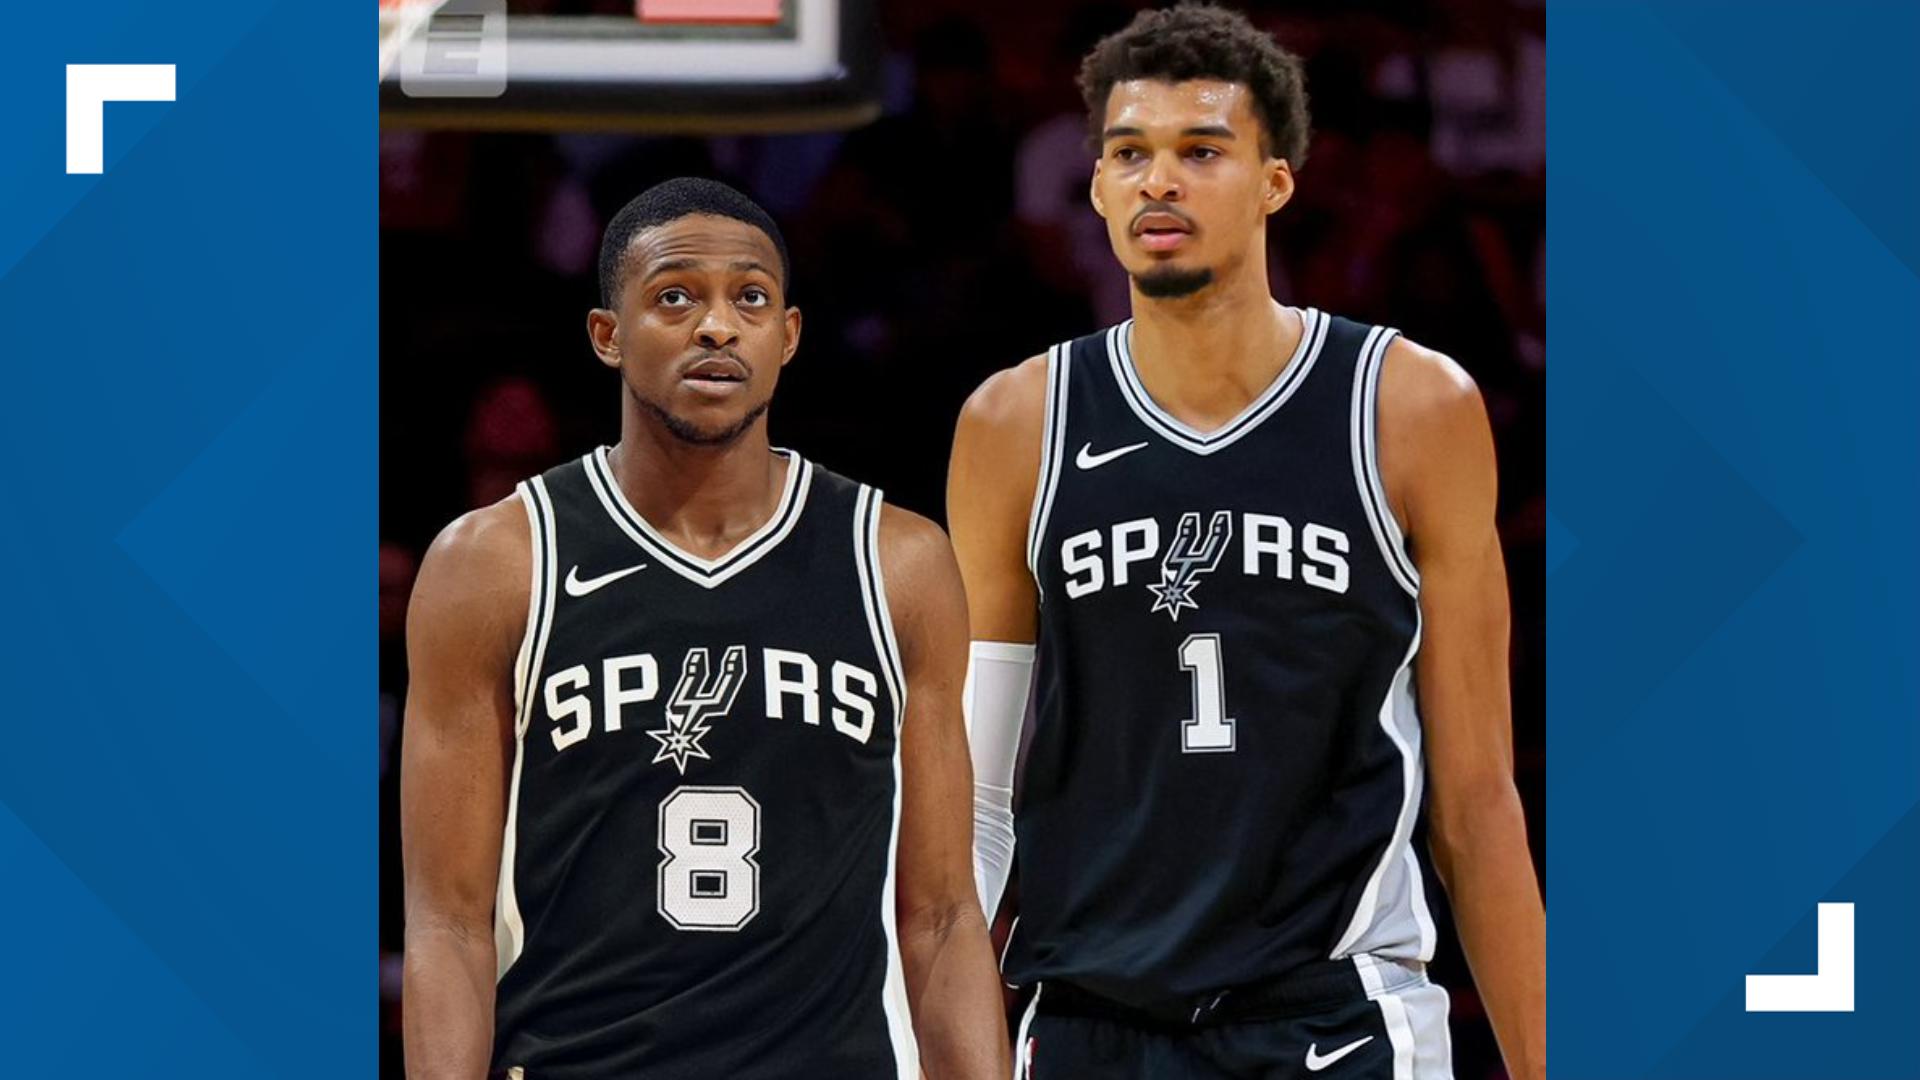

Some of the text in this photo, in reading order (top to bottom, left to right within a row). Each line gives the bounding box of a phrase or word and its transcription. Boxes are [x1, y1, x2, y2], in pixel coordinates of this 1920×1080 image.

[1061, 510, 1350, 622] SPURS
[544, 645, 878, 775] SPURS
[1178, 633, 1236, 753] 1
[657, 785, 761, 931] 8
